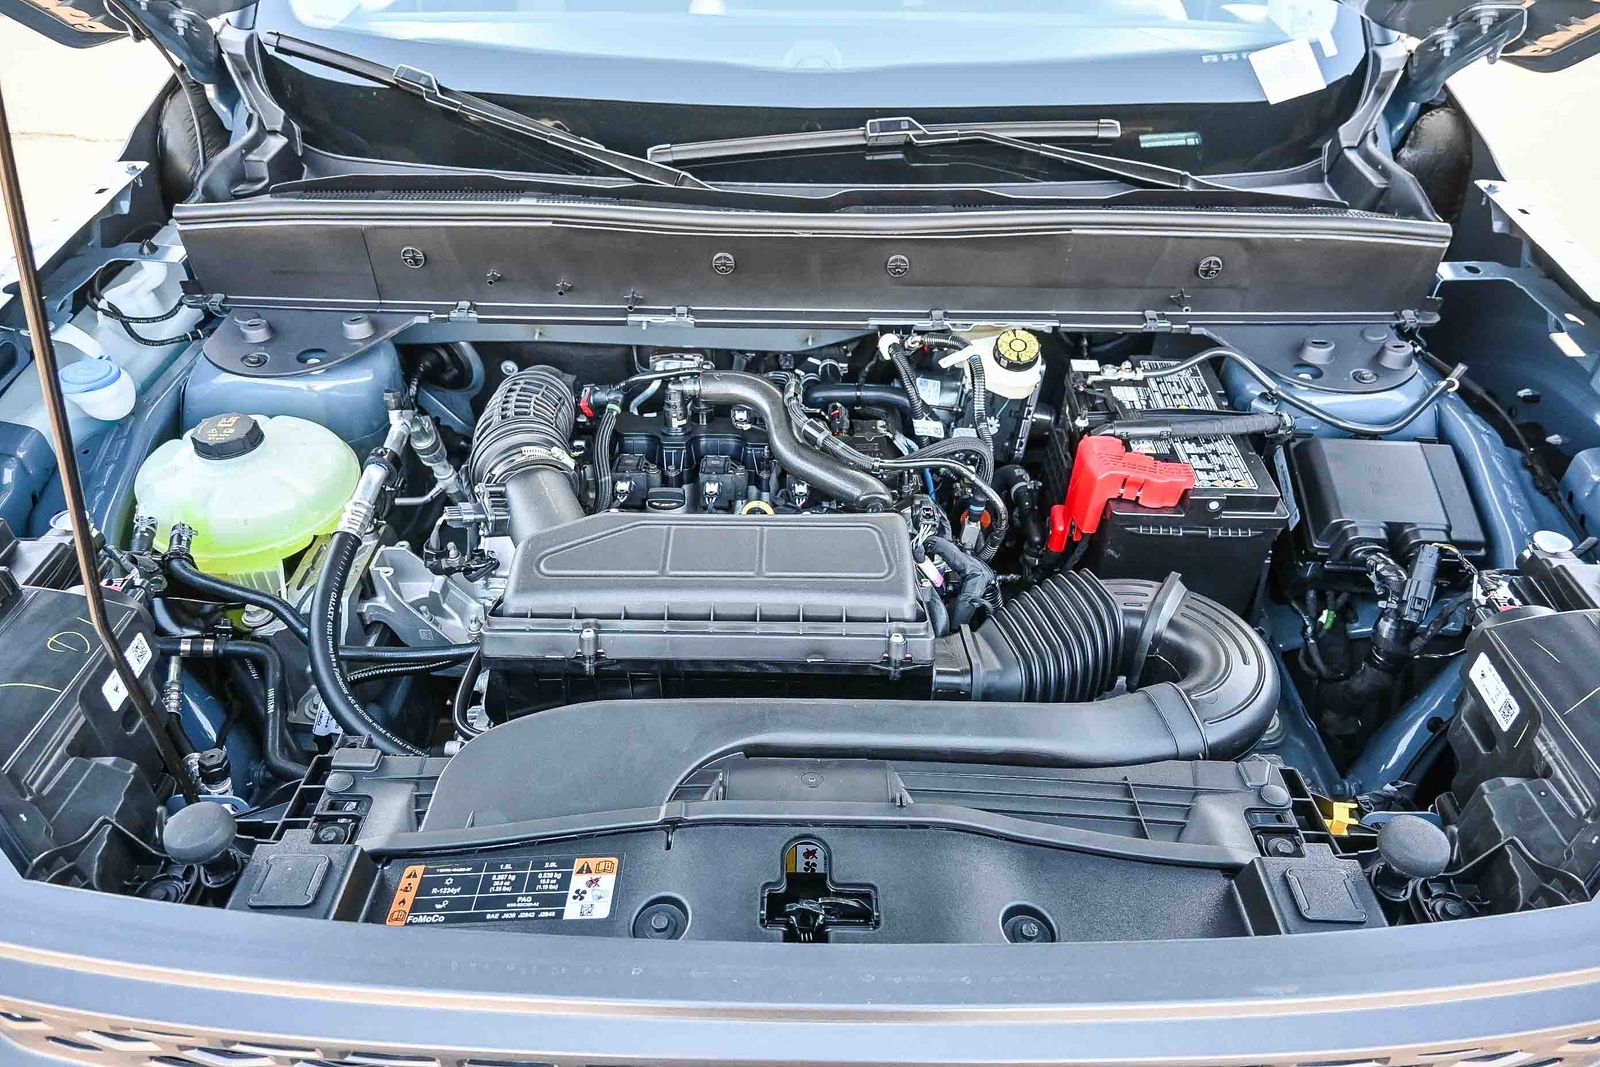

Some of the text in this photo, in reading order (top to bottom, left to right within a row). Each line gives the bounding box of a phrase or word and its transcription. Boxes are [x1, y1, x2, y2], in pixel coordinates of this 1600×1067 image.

[327, 592, 337, 621] GALAXY
[354, 703, 373, 724] SUCTION
[372, 722, 386, 735] HOSE
[406, 915, 445, 923] FoMoCo
